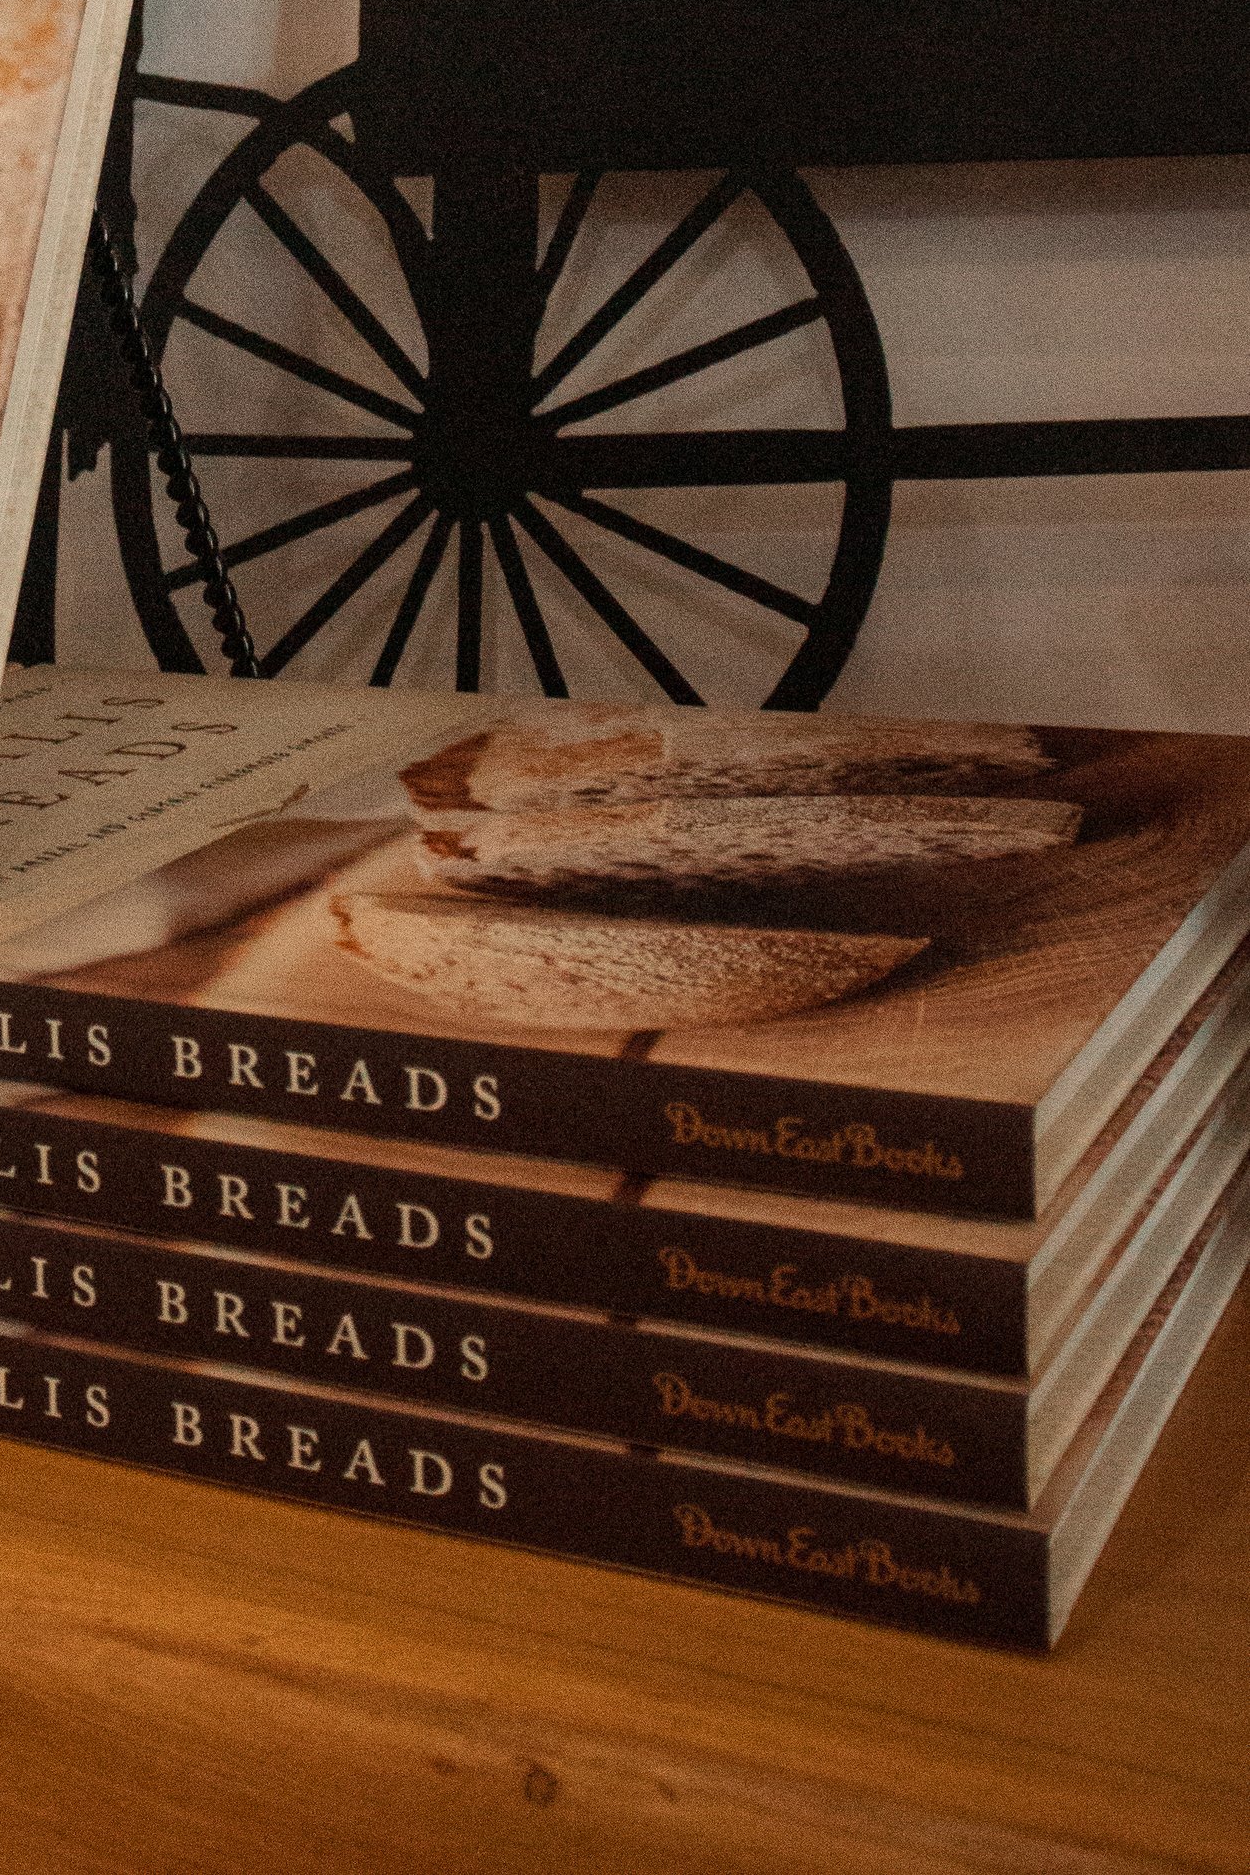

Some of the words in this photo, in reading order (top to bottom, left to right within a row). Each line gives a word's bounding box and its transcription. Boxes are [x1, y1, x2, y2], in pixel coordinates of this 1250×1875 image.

[171, 1034, 500, 1121] BREADS
[161, 1164, 494, 1260] BREADS
[157, 1280, 488, 1382] BREADS
[171, 1401, 506, 1509] BREADS
